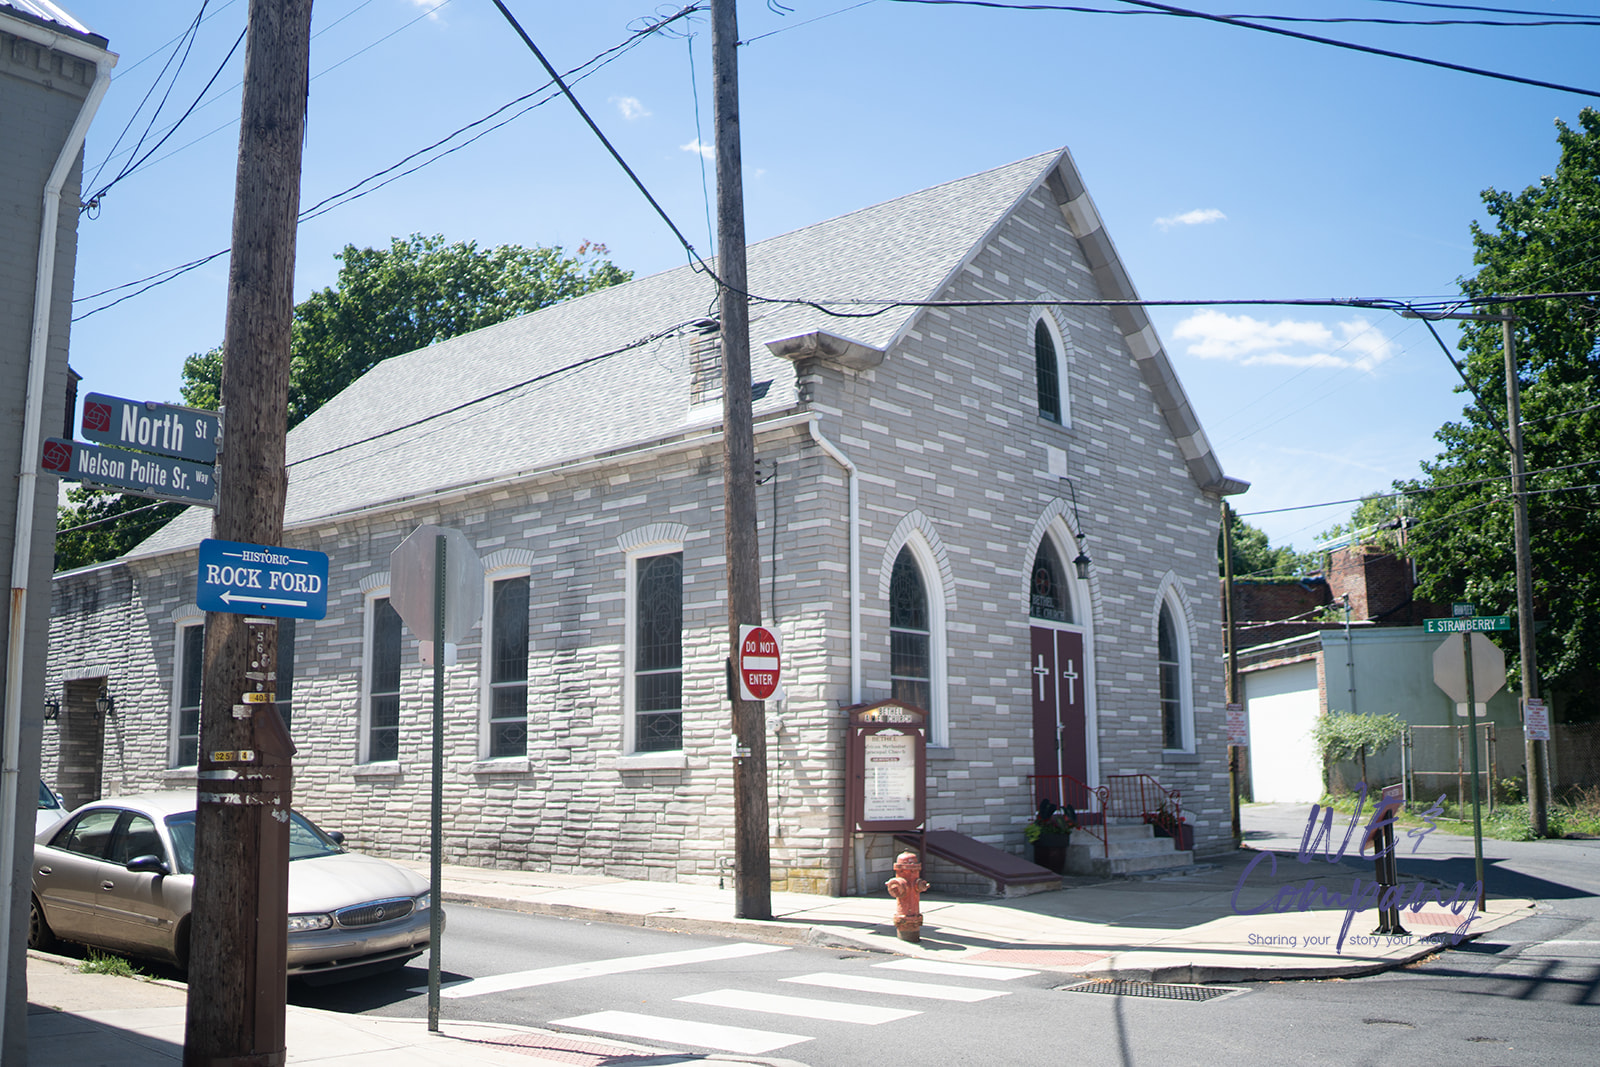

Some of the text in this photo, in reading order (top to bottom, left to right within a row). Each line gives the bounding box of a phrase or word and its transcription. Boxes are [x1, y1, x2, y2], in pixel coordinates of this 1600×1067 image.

[120, 404, 207, 451] North St
[78, 449, 209, 490] Nelson Polite Sr. Way
[242, 551, 289, 565] HISTORIC
[205, 564, 321, 593] ROCK FORD
[1428, 621, 1434, 632] E
[1437, 619, 1496, 632] STRAWBERRY
[745, 641, 775, 654] DO NOT
[749, 674, 773, 686] ENTER
[879, 706, 903, 715] BETHEL
